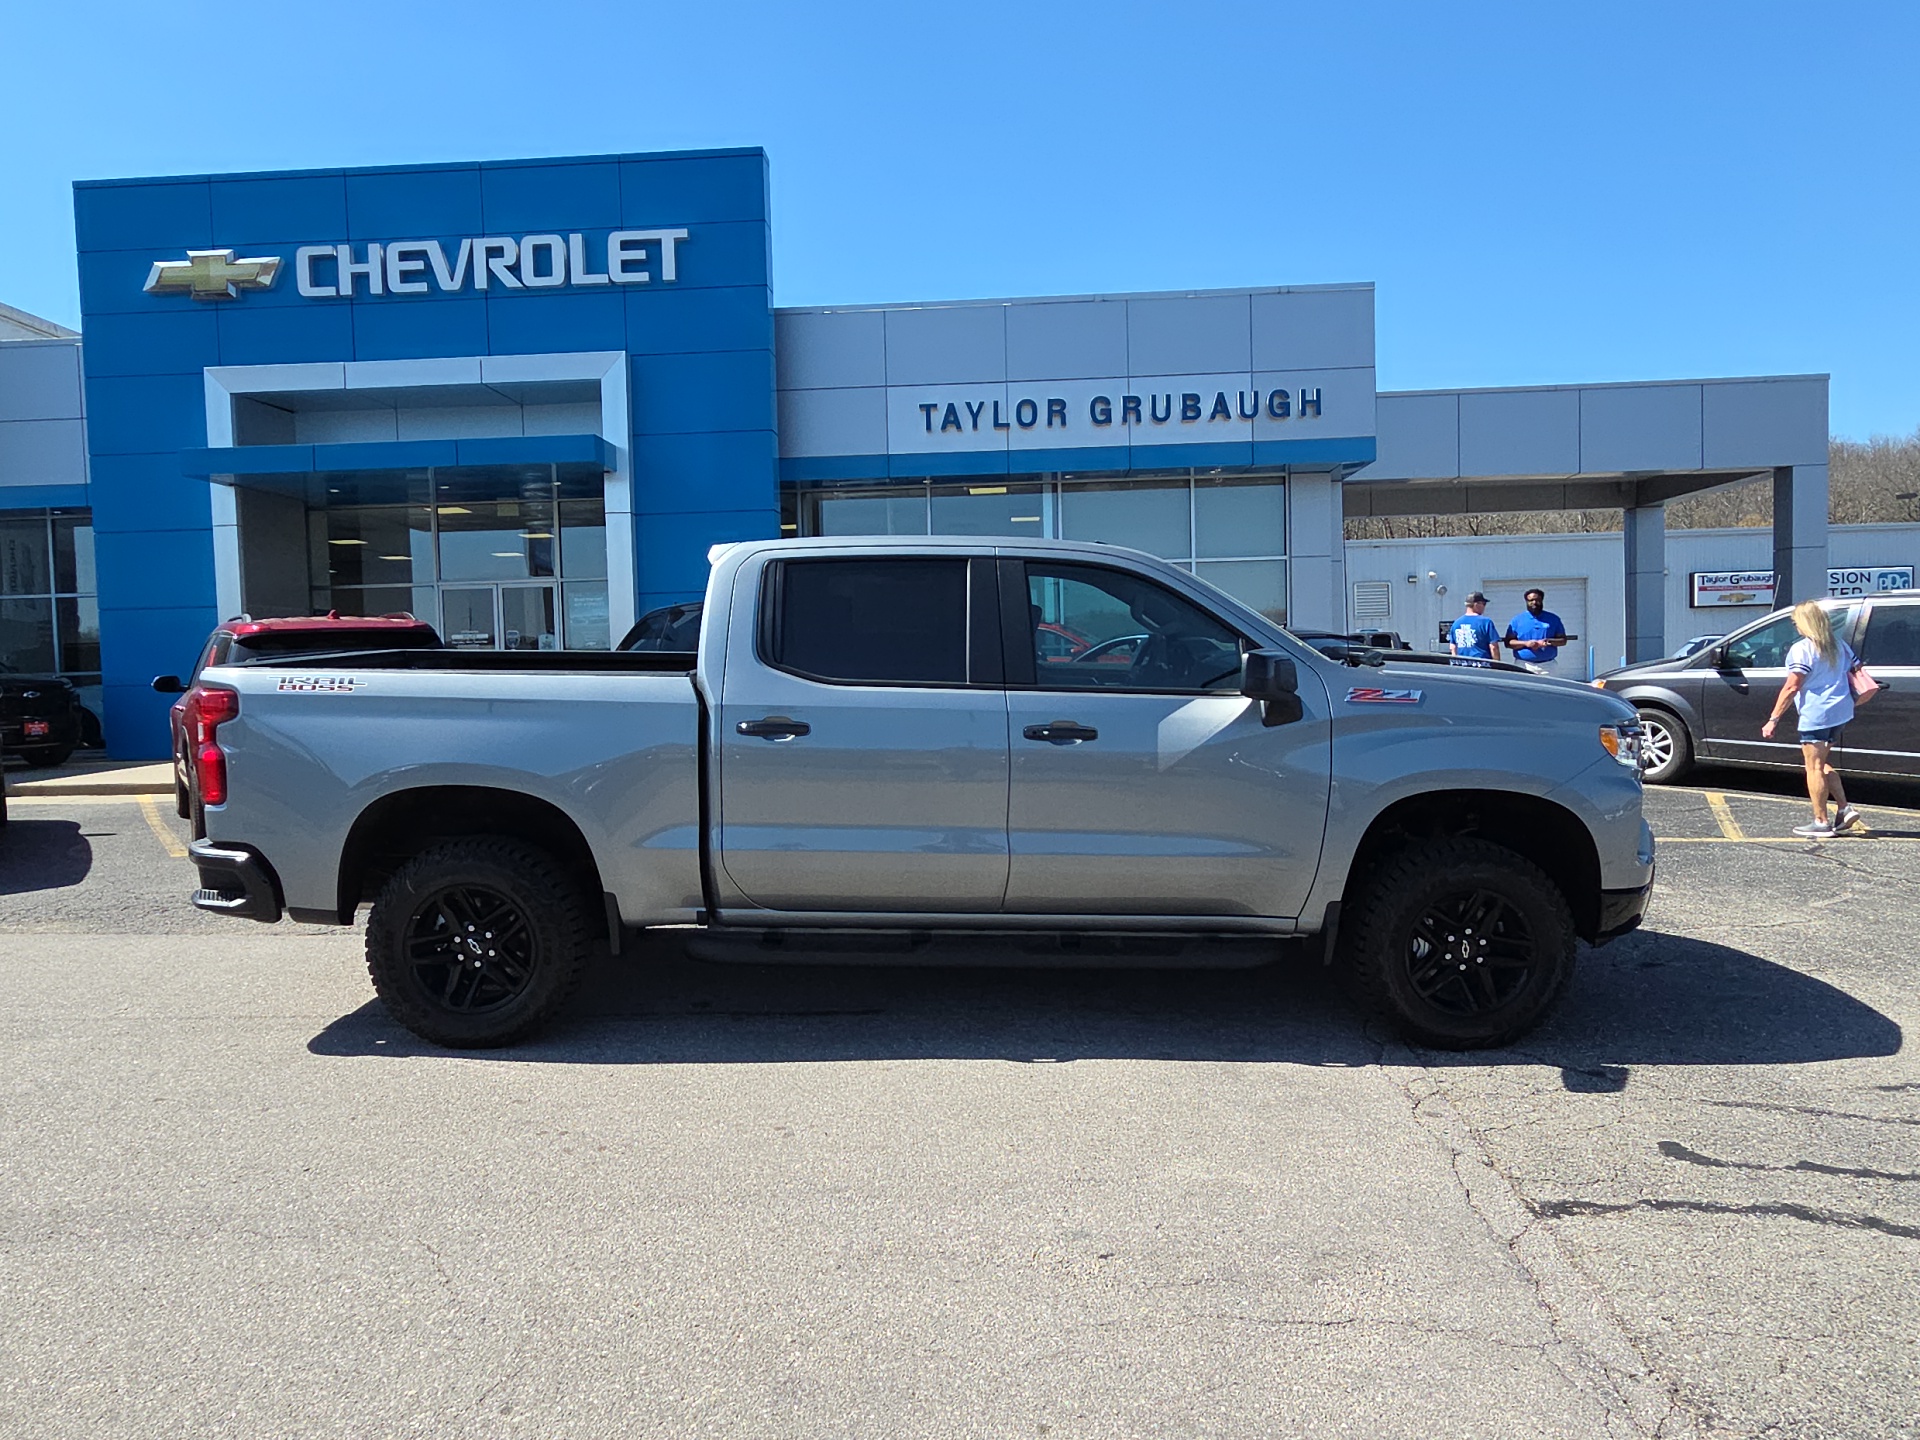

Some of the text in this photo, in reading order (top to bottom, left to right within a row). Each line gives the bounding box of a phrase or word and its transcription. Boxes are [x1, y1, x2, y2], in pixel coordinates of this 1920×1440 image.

[296, 228, 688, 297] CHEVROLET
[919, 388, 1322, 432] TAYLOR GRUBAUGH
[1698, 575, 1728, 585] Taylor
[1829, 572, 1871, 584] SION
[1879, 573, 1909, 591] PPG
[268, 676, 367, 685] TRAIL
[278, 684, 354, 692] BOSS
[1344, 687, 1423, 703] Z71
